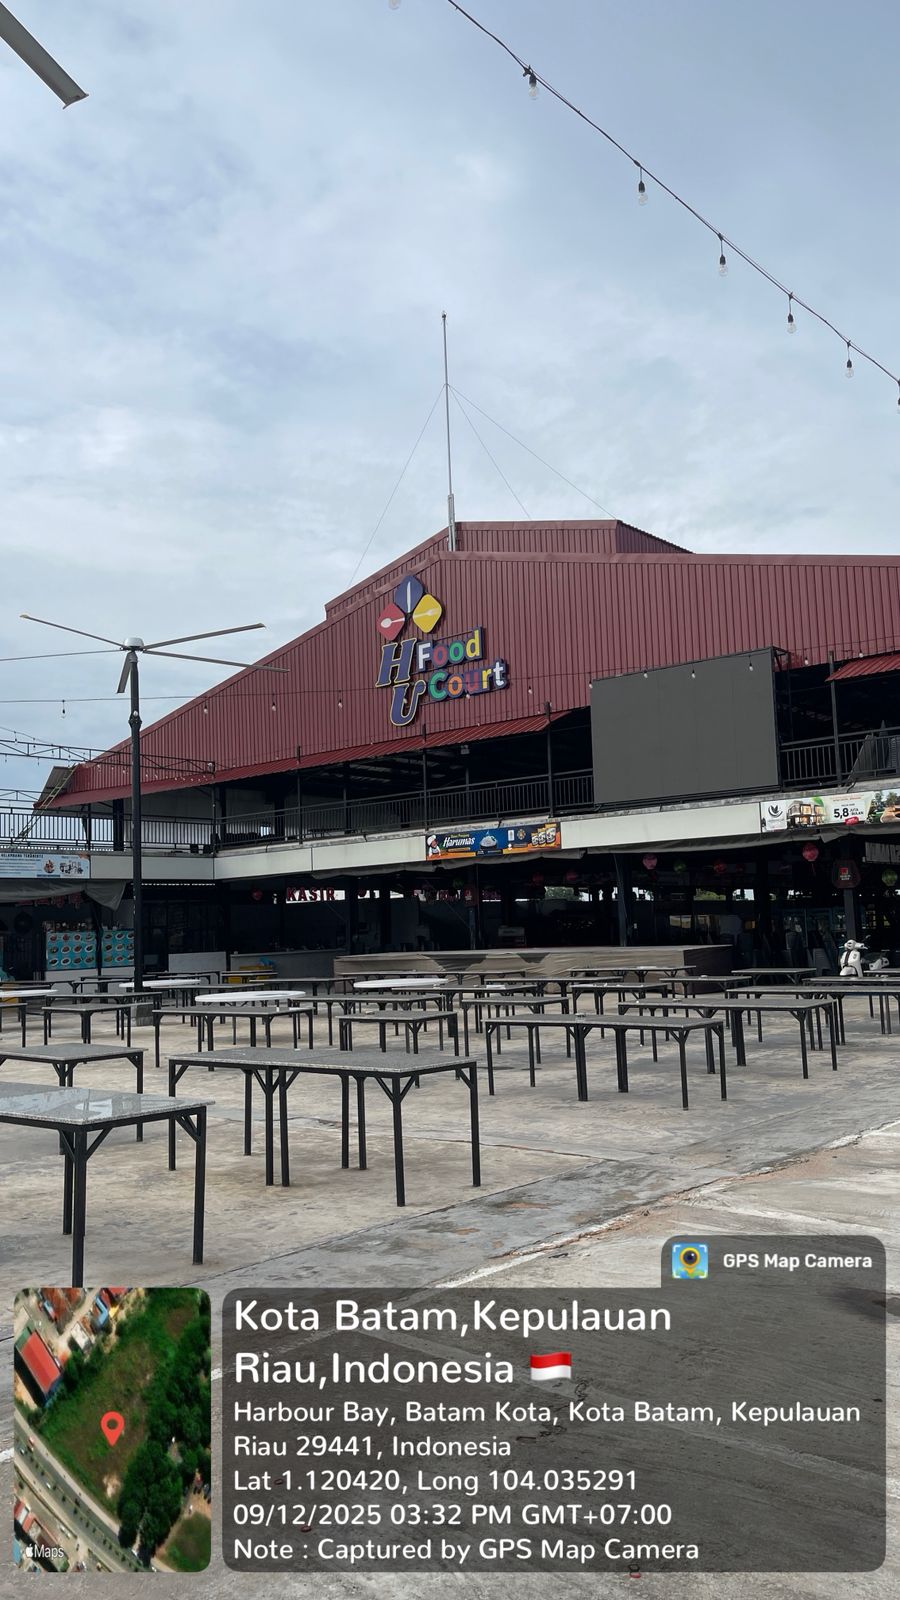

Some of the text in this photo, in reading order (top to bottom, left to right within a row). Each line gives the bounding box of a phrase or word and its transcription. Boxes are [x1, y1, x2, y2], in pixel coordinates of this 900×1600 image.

[417, 629, 482, 670] Food
[429, 661, 505, 698] Court
[833, 807, 849, 819] 5,8
[443, 837, 476, 847] Harumas
[286, 887, 336, 902] KASIR
